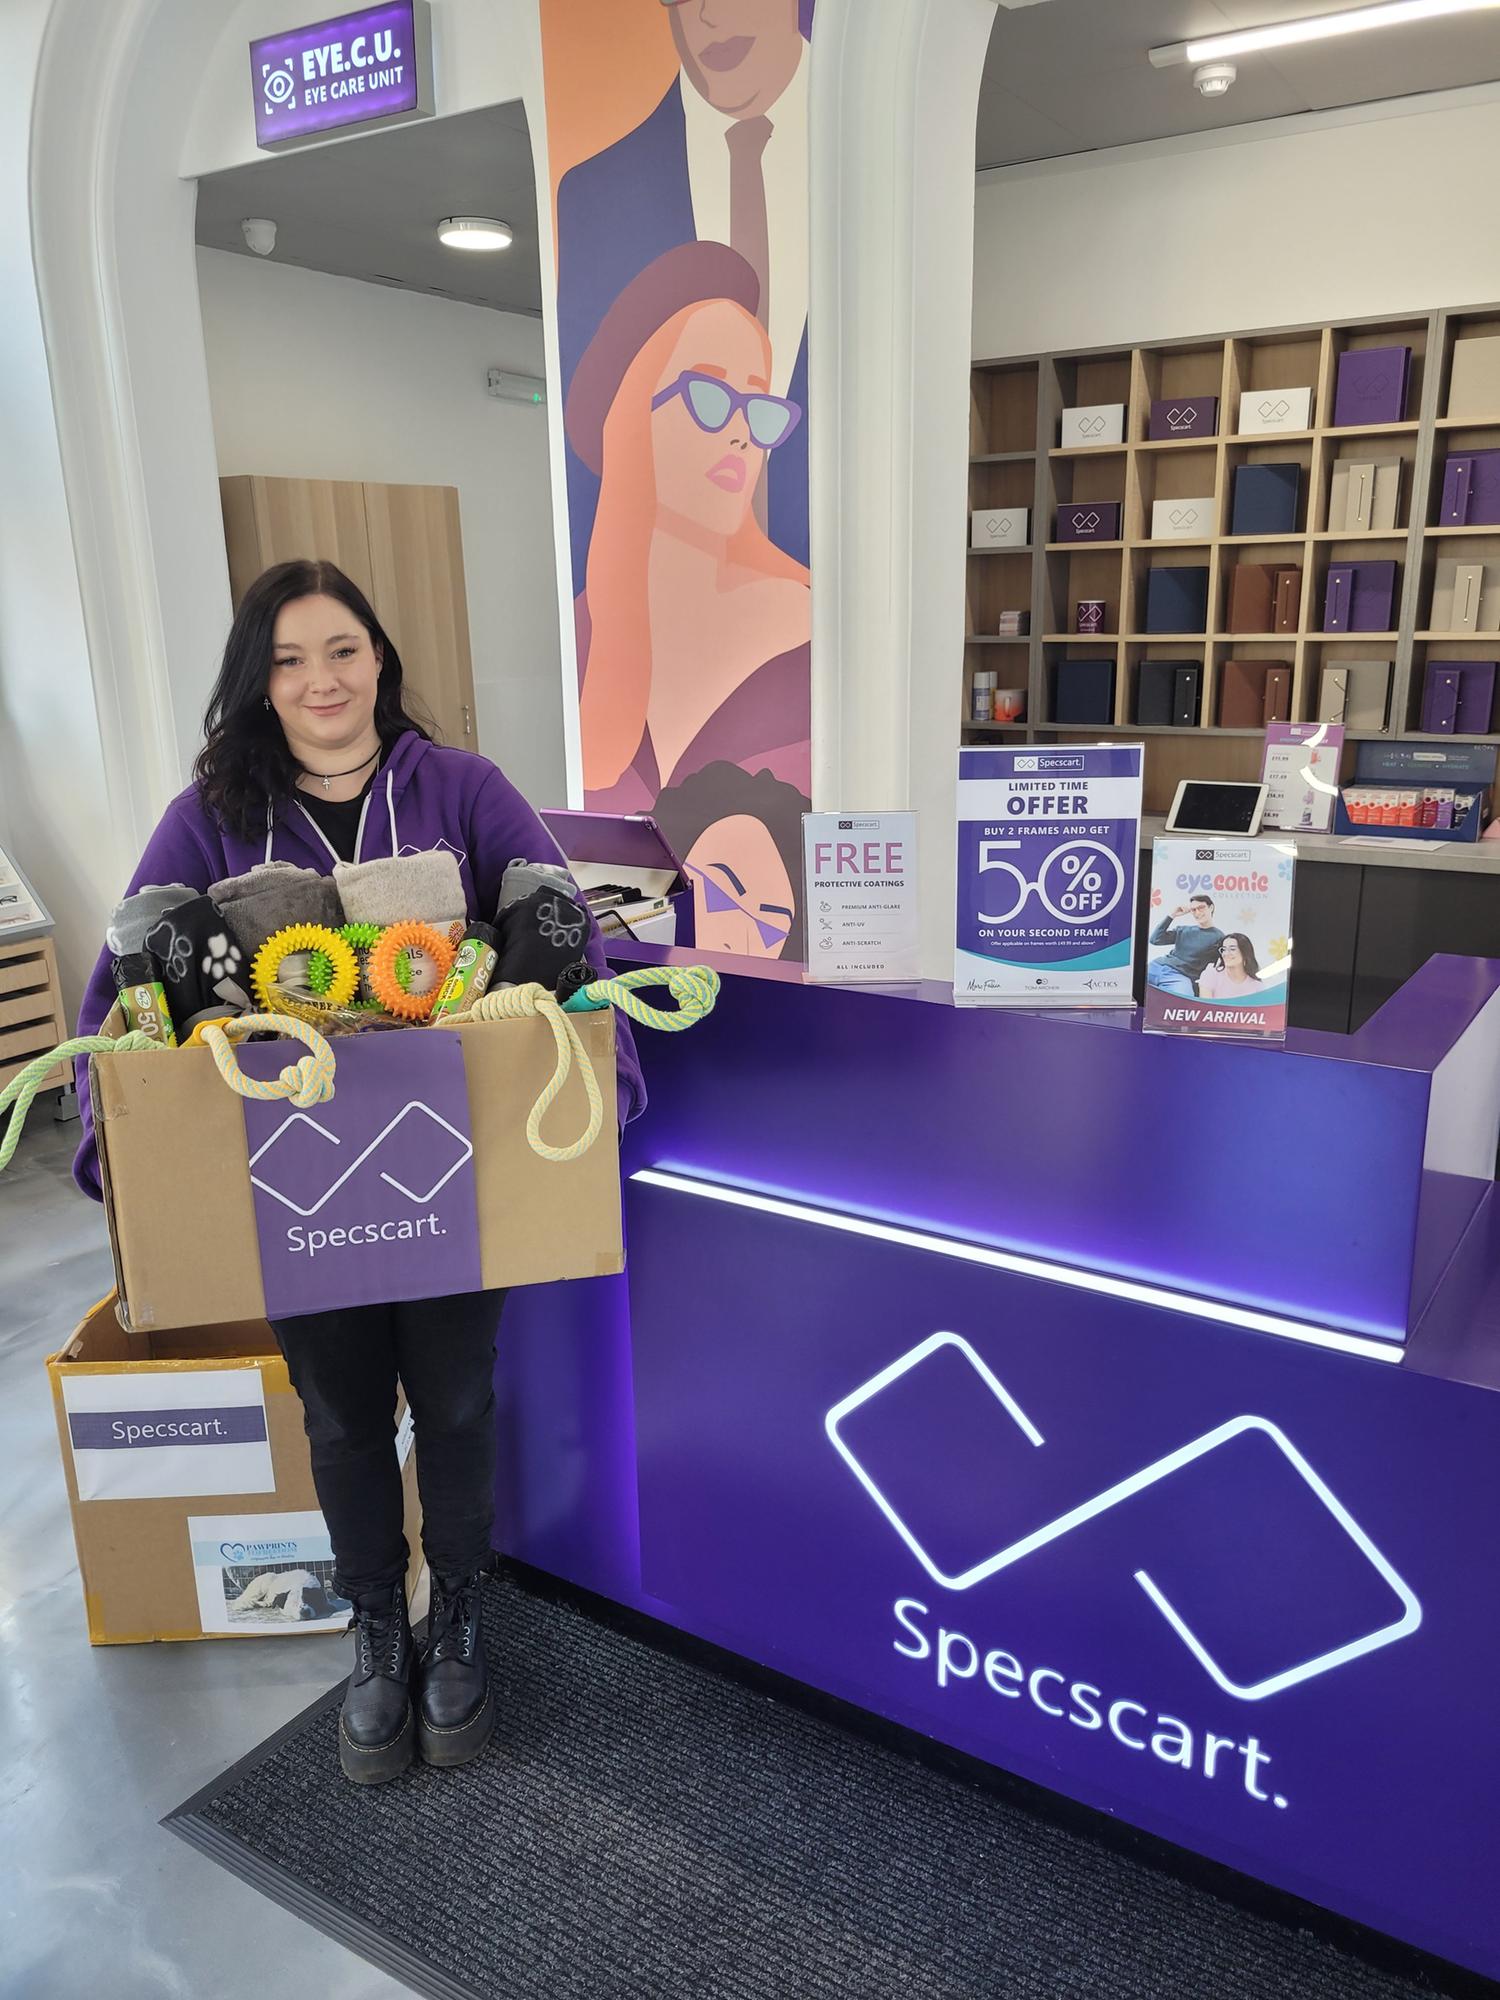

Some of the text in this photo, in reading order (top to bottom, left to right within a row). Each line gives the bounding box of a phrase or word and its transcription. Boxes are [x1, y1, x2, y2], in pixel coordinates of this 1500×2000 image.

[302, 29, 401, 81] EYE.C.U.
[304, 66, 404, 106] EYE CARE UNIT
[1039, 758, 1081, 768] Specscart.
[1008, 781, 1089, 791] LIMITED TIME
[1007, 796, 1089, 815] OFFER
[984, 826, 1110, 836] BUY 2 FRAMES AND GET
[815, 842, 904, 874] FREE
[1175, 871, 1269, 894] eyeconic
[1060, 893, 1103, 911] OFF
[978, 928, 1109, 937] ON YOUR SECOND FRAME
[473, 967, 490, 991] 50
[137, 1011, 159, 1036] 50
[1163, 1008, 1267, 1025] NEW ARRIVAL
[286, 1213, 447, 1257] Specscart.
[111, 1418, 228, 1443] Specscart.
[246, 1541, 297, 1551] PAWPRINTS
[892, 1597, 1289, 1810] Specscart.
